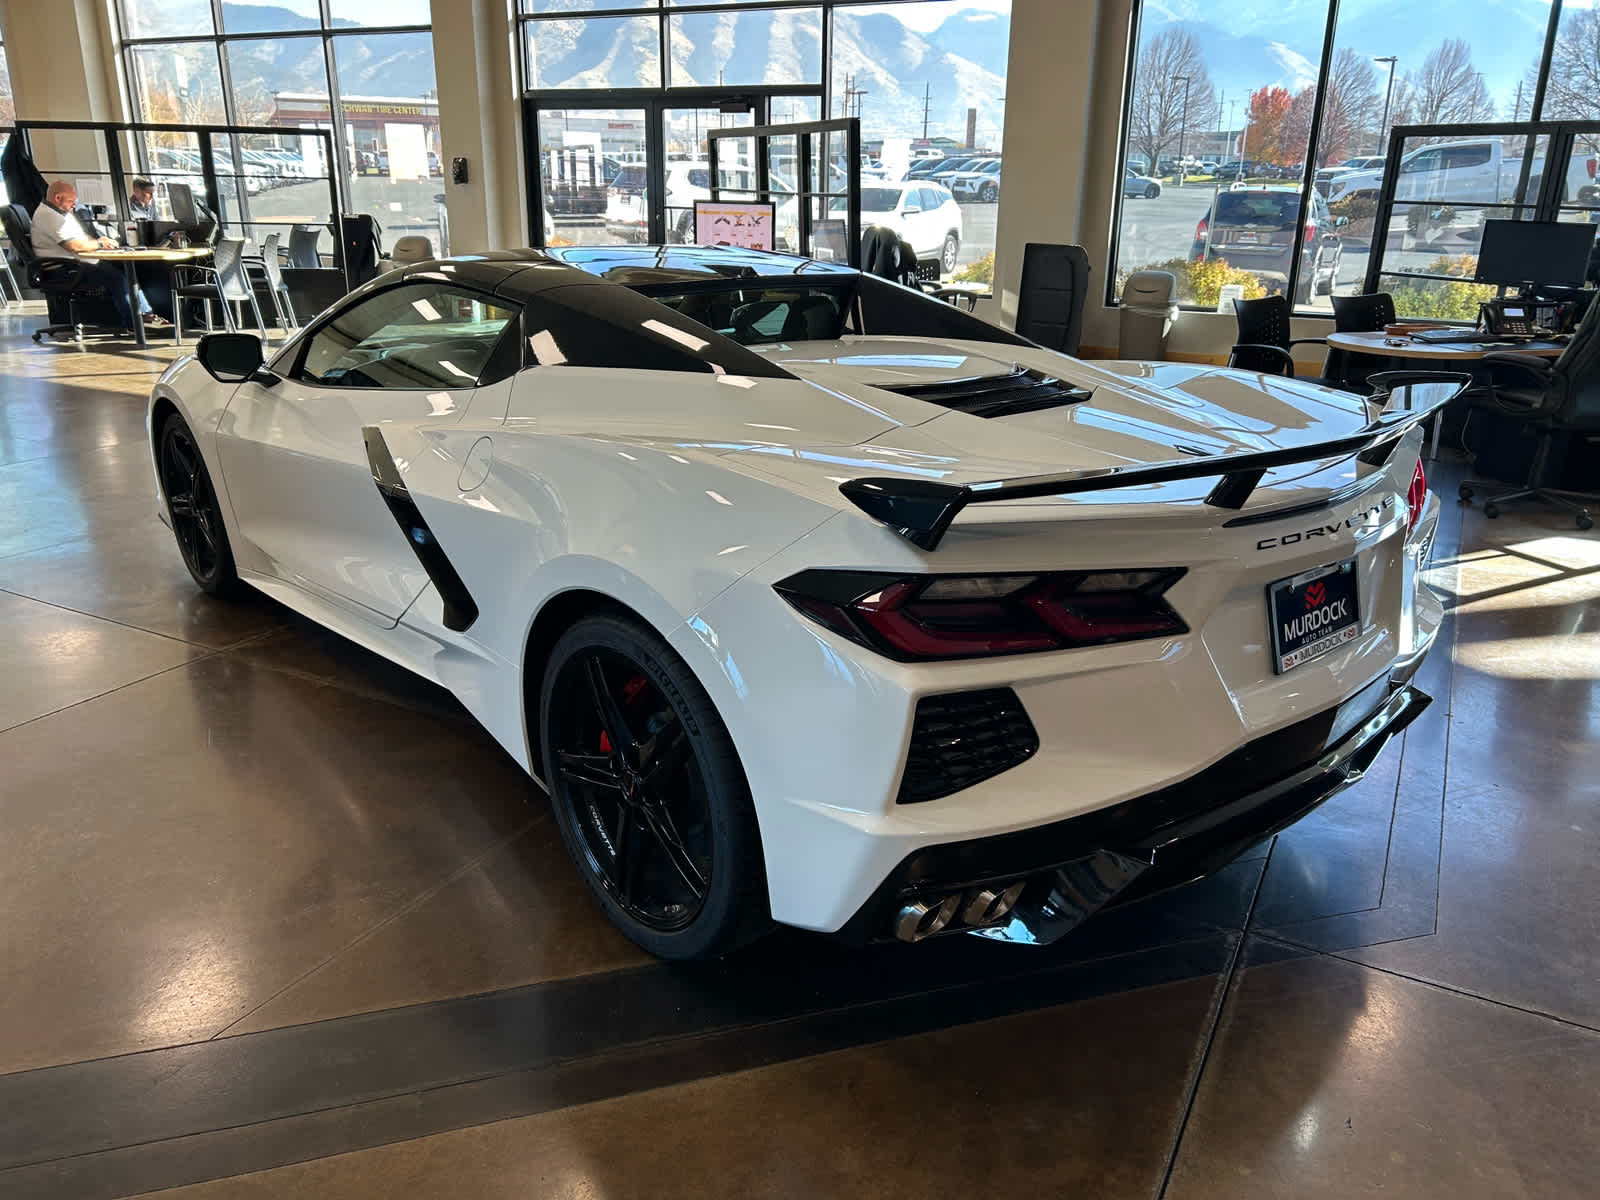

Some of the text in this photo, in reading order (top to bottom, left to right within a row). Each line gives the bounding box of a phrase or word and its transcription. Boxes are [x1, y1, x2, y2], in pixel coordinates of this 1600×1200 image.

[1257, 496, 1394, 550] CORVETTE
[1284, 598, 1348, 642] MURDOCK
[1299, 633, 1344, 661] MURDOCK
[1302, 633, 1317, 644] AUTO
